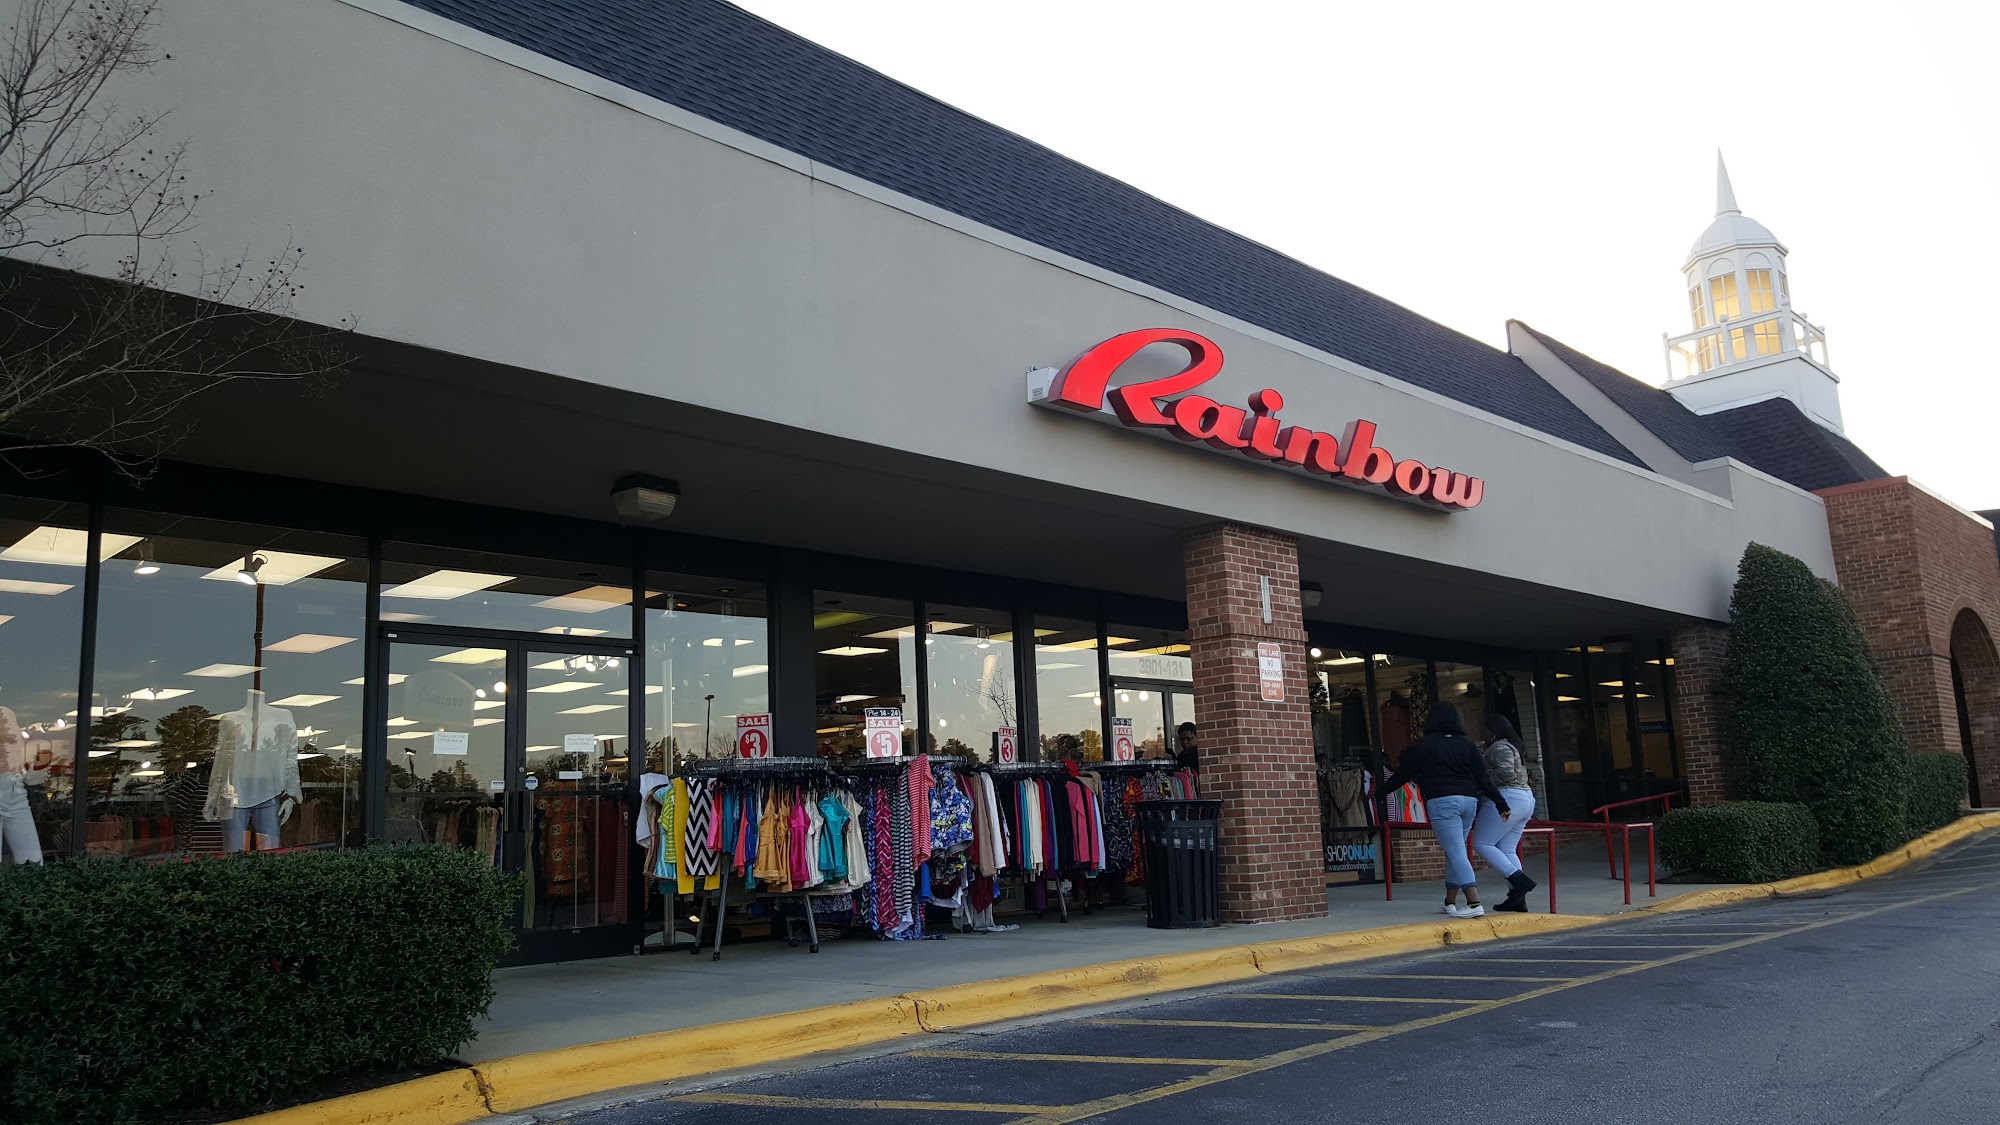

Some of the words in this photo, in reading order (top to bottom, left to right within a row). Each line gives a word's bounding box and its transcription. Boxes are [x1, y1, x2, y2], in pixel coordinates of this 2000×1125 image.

[1050, 328, 1484, 509] Rainbow
[1139, 658, 1183, 677] 3901-131
[1267, 659, 1274, 667] NO
[1261, 669, 1281, 678] PARKING
[739, 716, 768, 727] SALE
[869, 719, 899, 728] SALE
[1000, 728, 1014, 737] SALE
